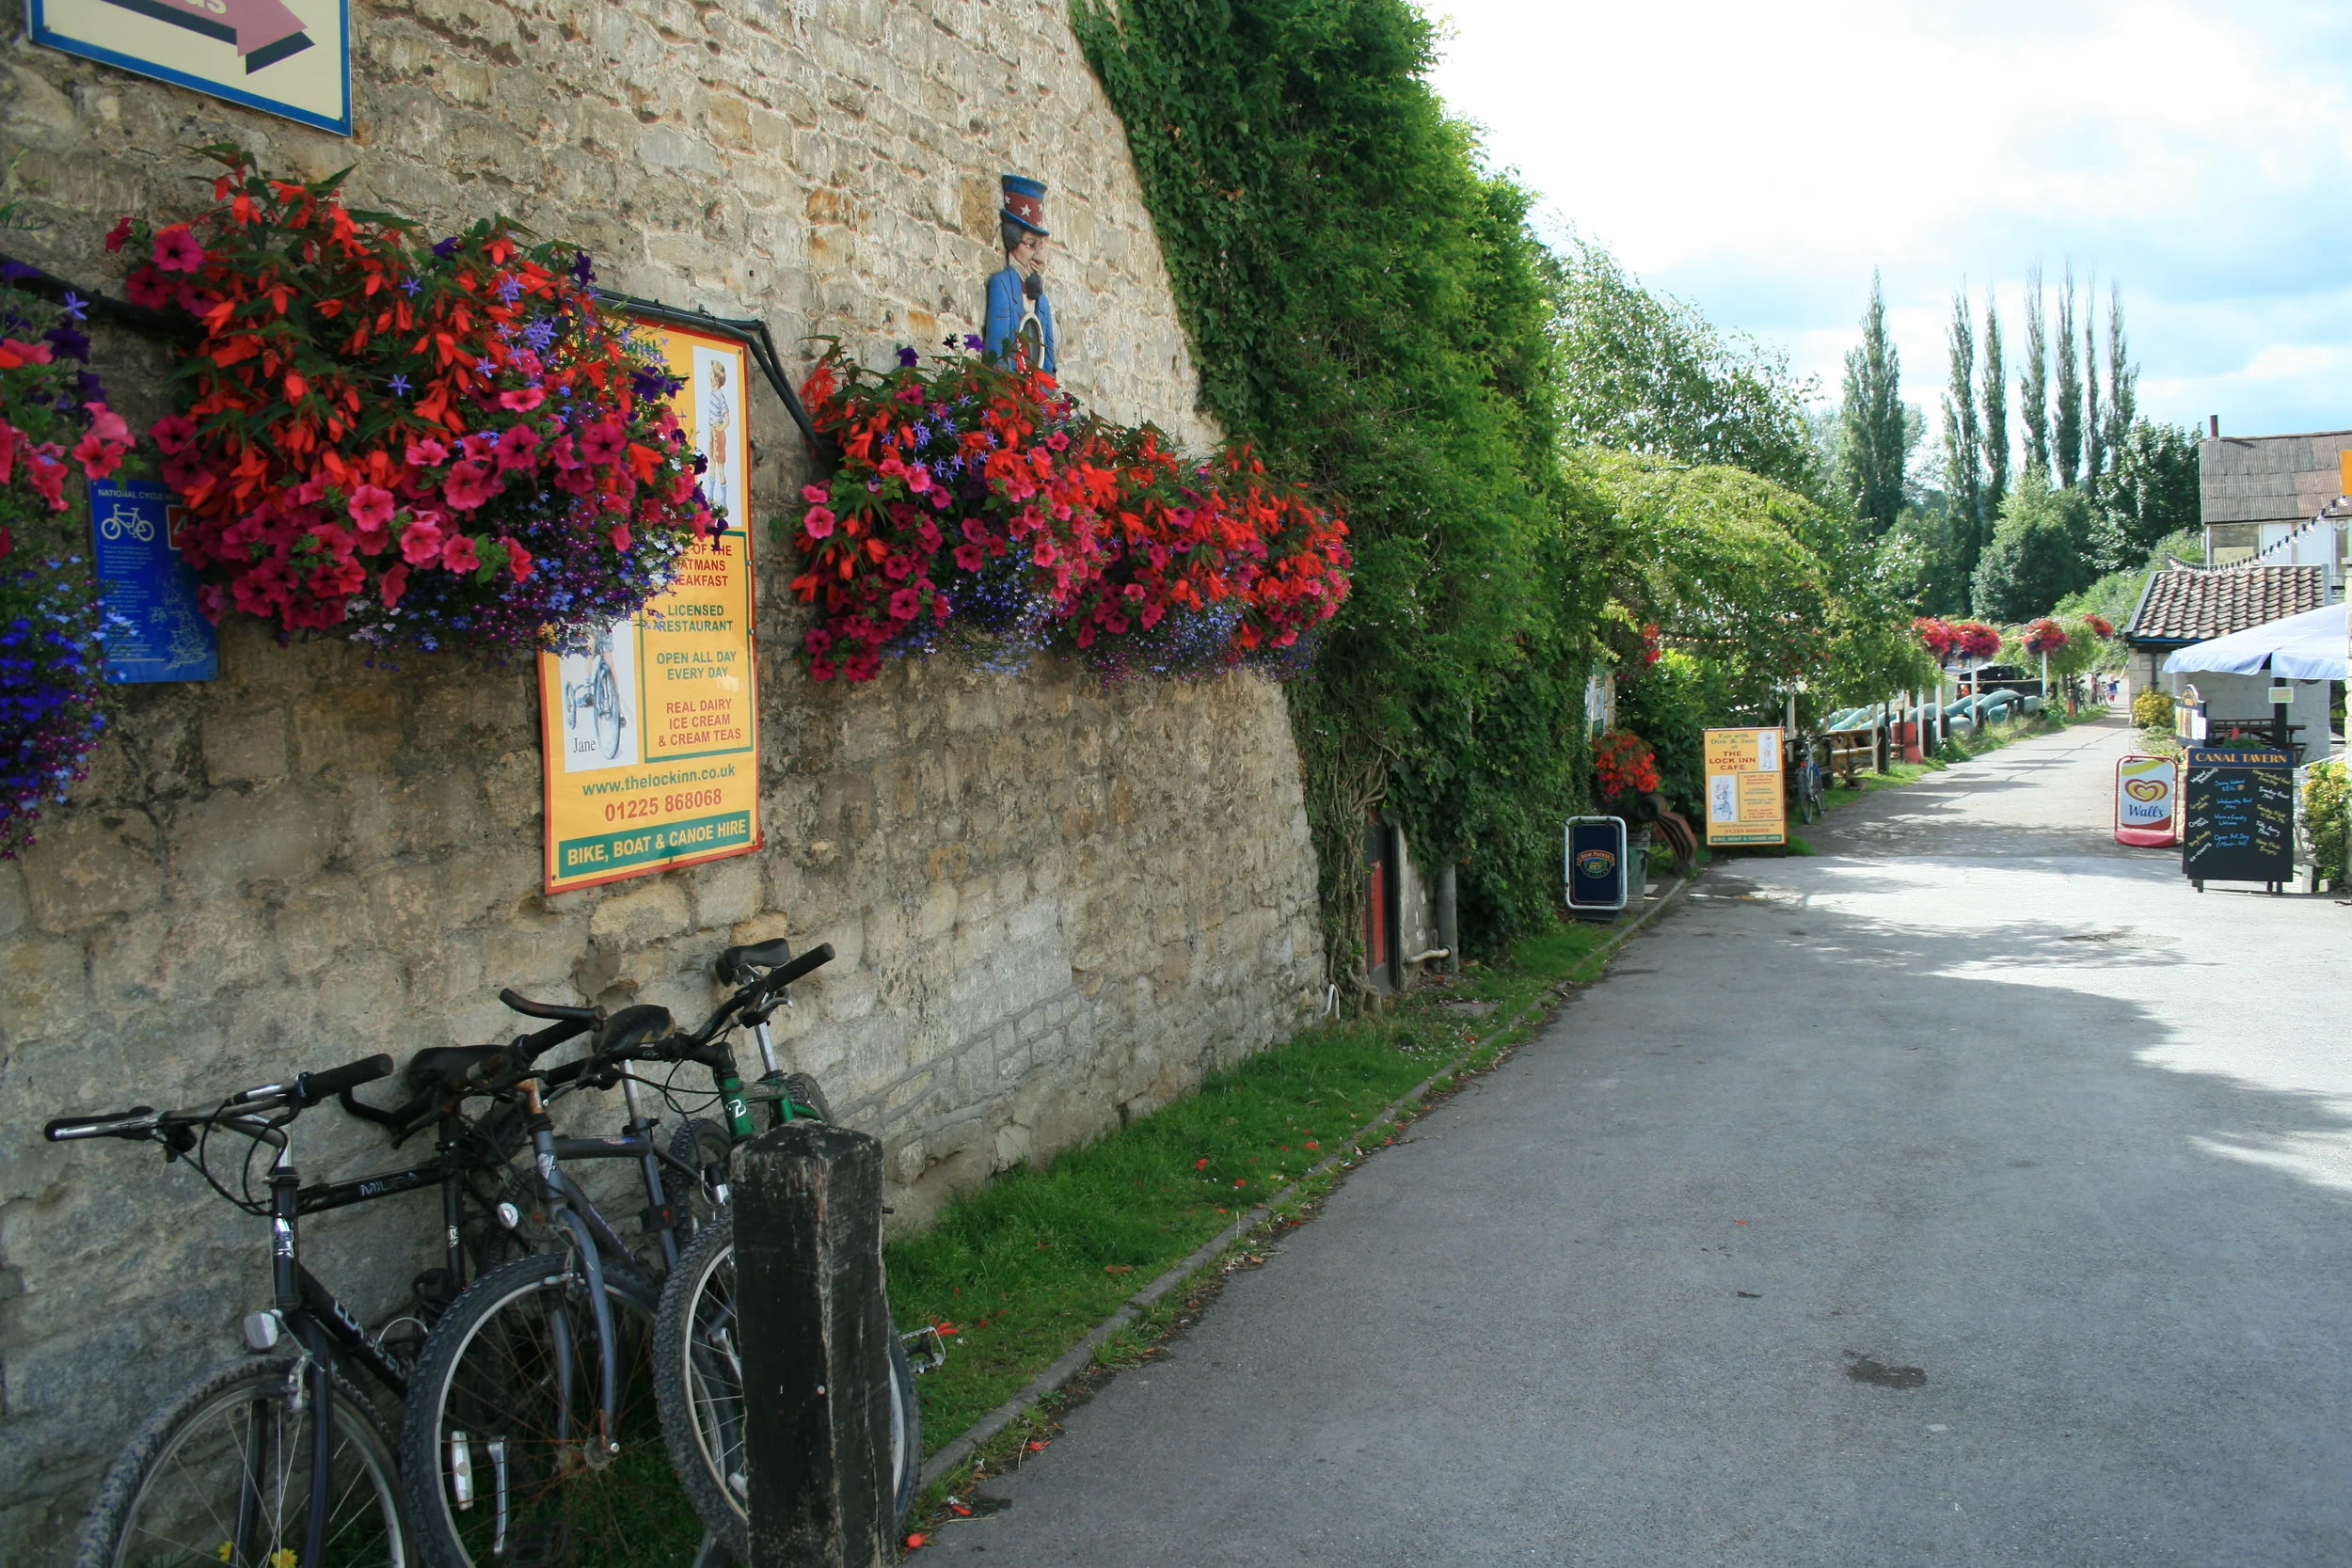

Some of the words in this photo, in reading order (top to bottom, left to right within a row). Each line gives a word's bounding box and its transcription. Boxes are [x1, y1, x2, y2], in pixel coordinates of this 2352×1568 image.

[98, 488, 138, 499] NATIONAL
[138, 491, 164, 500] CYCLE
[693, 544, 707, 555] OF
[677, 558, 726, 571] ATMANS
[675, 575, 729, 587] EAKFAST
[667, 605, 724, 617] LICENSED
[658, 620, 734, 632] RESTAURANT
[656, 652, 689, 665] OPEN
[692, 652, 713, 664] ALL
[716, 651, 737, 663] DAY
[667, 667, 704, 681] EVERY
[708, 666, 728, 679] DAY
[666, 702, 696, 714] REAL
[700, 698, 733, 712] DAIRY
[669, 718, 688, 730] ICE
[691, 714, 731, 728] CREAM
[573, 736, 596, 753] Jane
[658, 735, 667, 747] &
[670, 731, 710, 746] CREAM
[713, 728, 741, 742] TEAS
[2195, 752, 2239, 762] CANAL
[2241, 753, 2288, 763] TAVERN
[581, 763, 736, 797] www.thelockinn.co.uk
[605, 798, 659, 822] 01225
[664, 788, 723, 814] 868068
[2128, 804, 2164, 818] Wall's
[567, 844, 610, 866] BIKE,
[613, 836, 651, 859] BOAT
[655, 835, 665, 848] &
[669, 824, 714, 846] CANOE
[718, 818, 747, 838] HIRE
